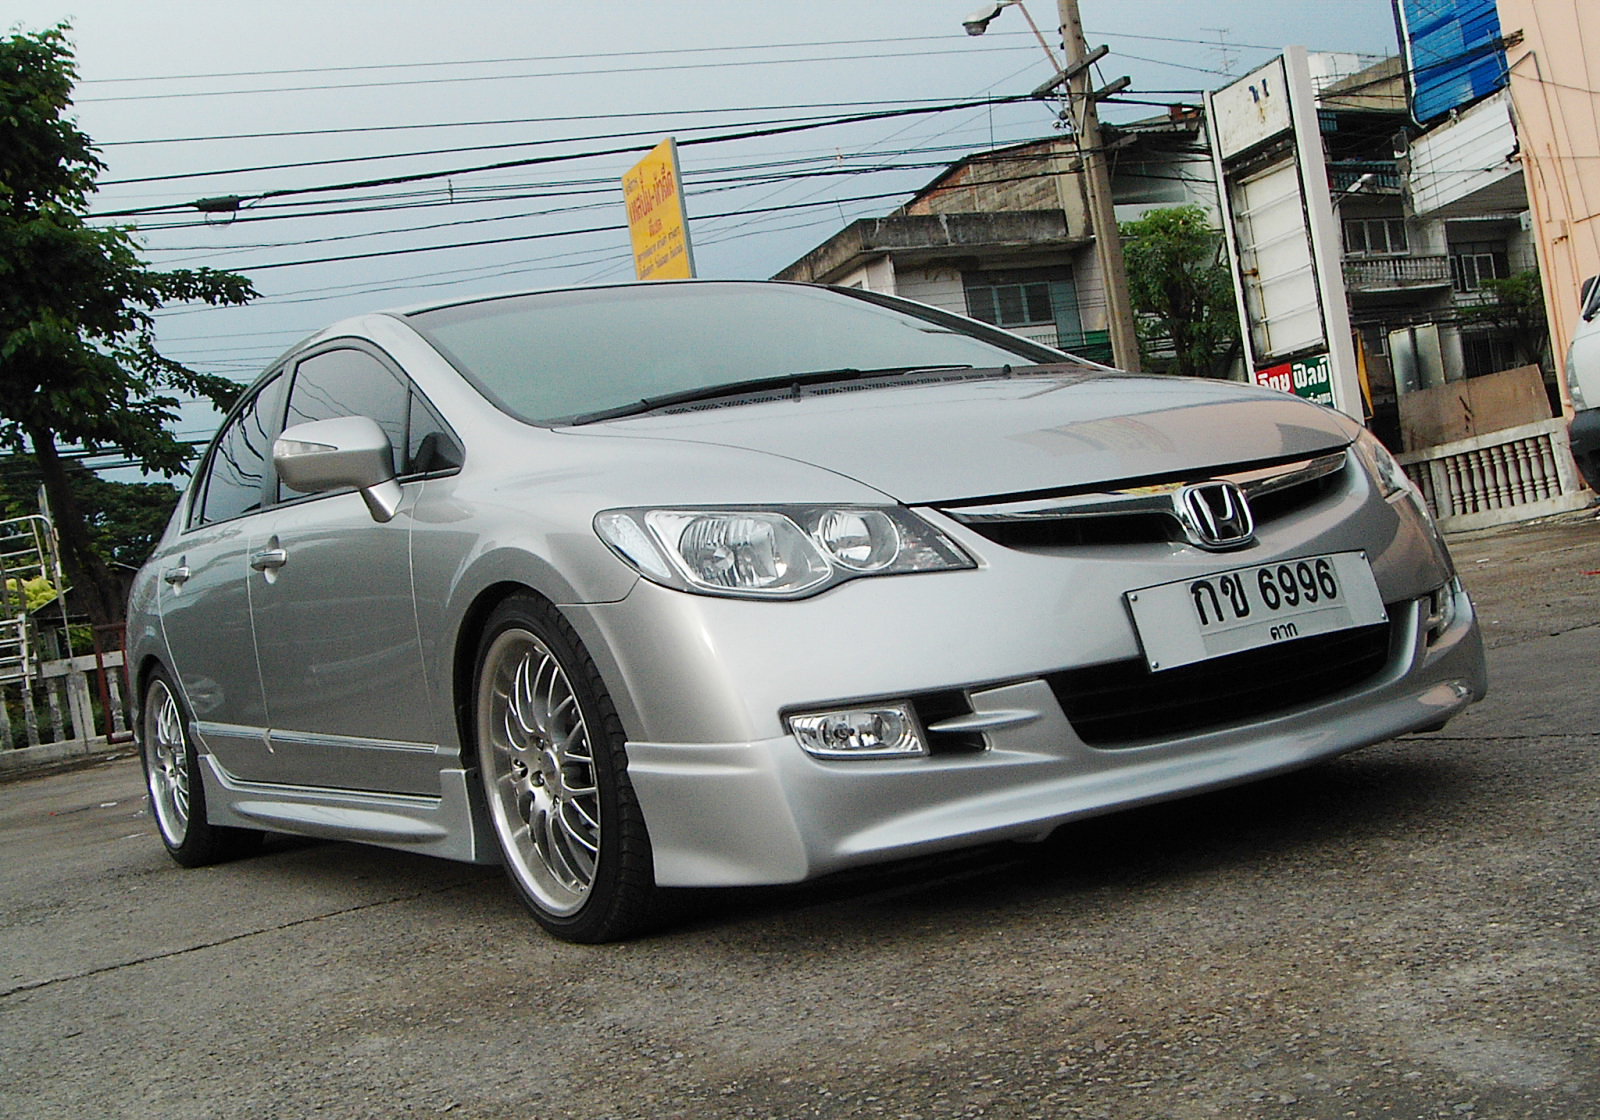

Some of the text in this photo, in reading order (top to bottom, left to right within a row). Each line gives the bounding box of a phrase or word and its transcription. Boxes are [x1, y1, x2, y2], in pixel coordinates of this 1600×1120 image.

[1190, 558, 1338, 626] กข 6996
[1270, 622, 1299, 641] ตาก
